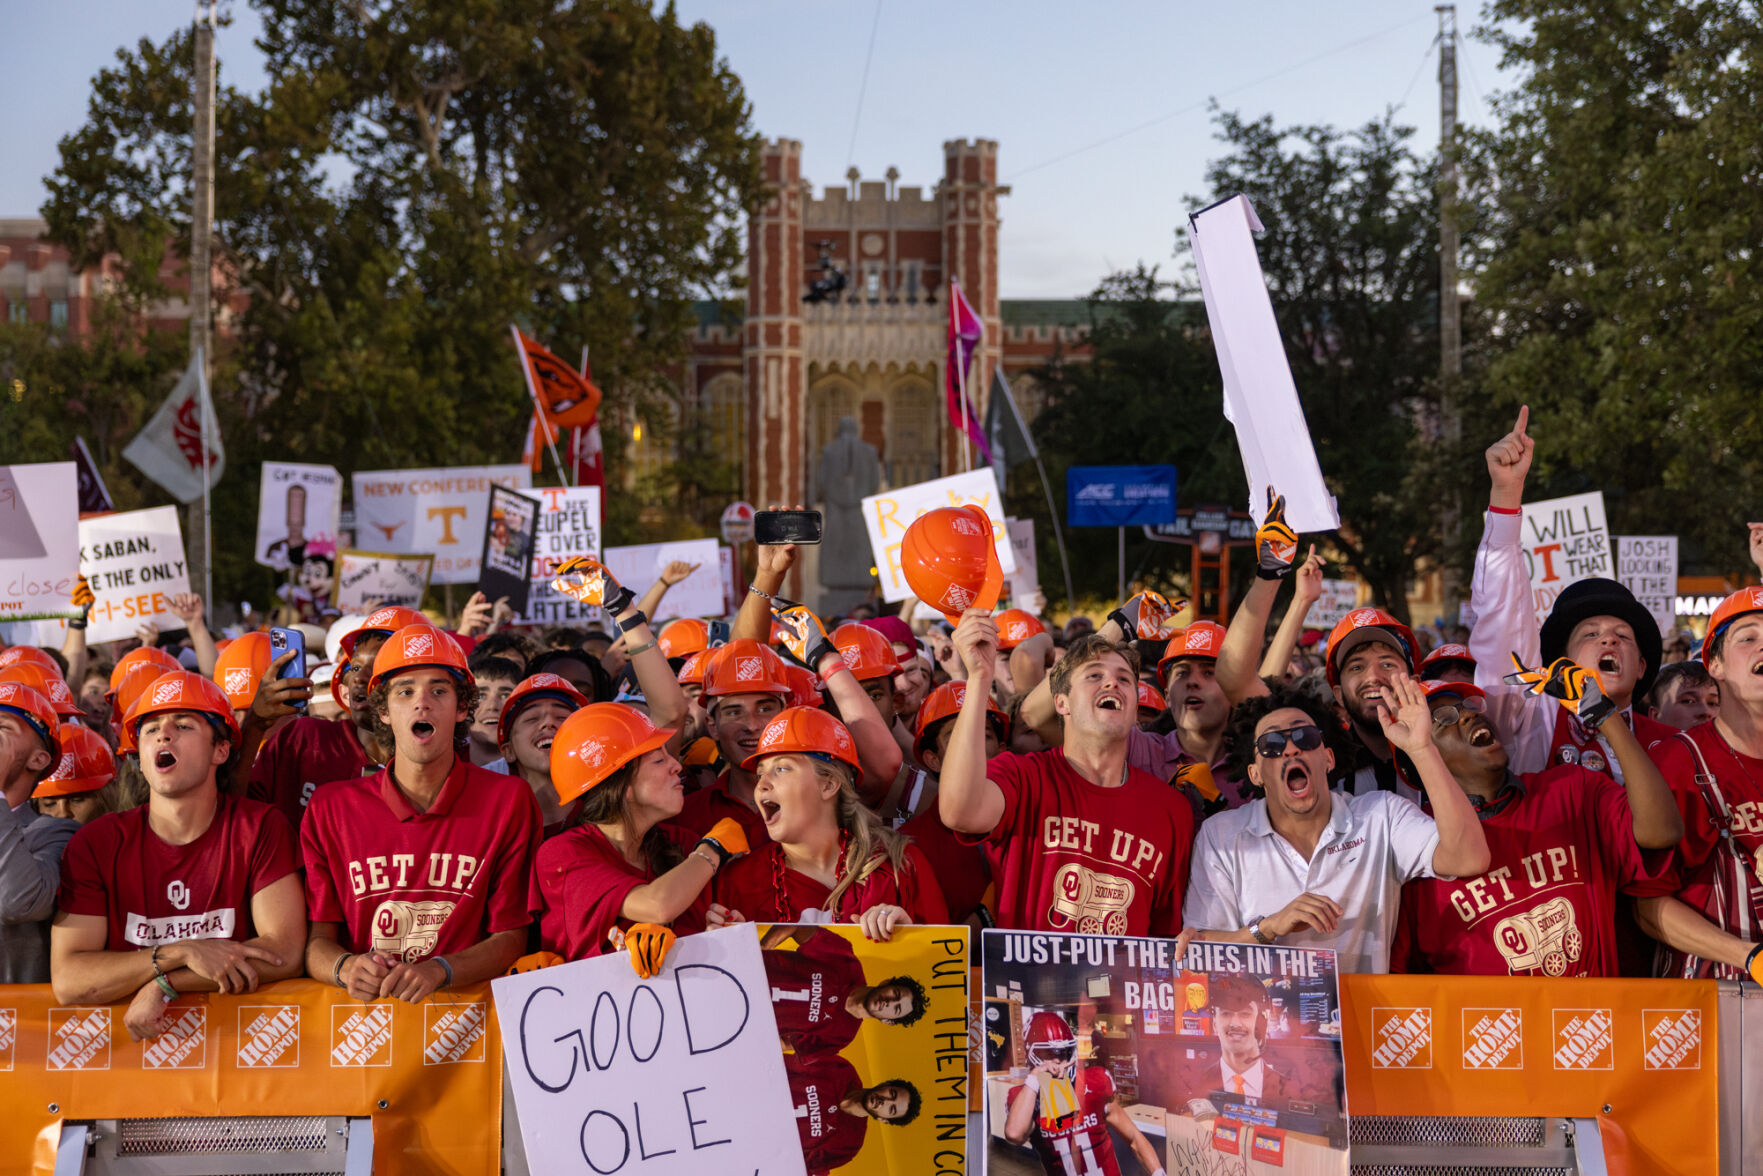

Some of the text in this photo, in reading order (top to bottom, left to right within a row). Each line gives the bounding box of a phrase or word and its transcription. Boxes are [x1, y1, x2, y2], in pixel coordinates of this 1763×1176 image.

[364, 482, 404, 497] NEW
[542, 489, 588, 511] THE
[875, 490, 990, 538] Rky
[1528, 506, 1602, 542] WILL
[93, 537, 156, 560] SABAN,
[551, 533, 595, 552] OVER
[1563, 534, 1606, 557] WEAR
[1622, 541, 1670, 557] JOSH
[105, 568, 135, 590] THE
[140, 562, 184, 583] ONLY
[1565, 553, 1609, 577] THAT
[1621, 559, 1671, 574] LOOKING
[7, 572, 72, 597] close
[1639, 578, 1667, 593] THE
[0, 601, 24, 611] POT
[1675, 597, 1725, 615] MAK
[404, 634, 433, 657] HOME
[1186, 630, 1212, 649] HOME
[225, 668, 250, 695] HOME
[737, 657, 761, 680] HOME
[153, 680, 183, 705] HOME
[1727, 801, 1763, 833] GE
[1044, 816, 1163, 880] GET UP!
[1327, 837, 1366, 854] OKLAHOMA
[349, 853, 485, 895] GET UP!
[1062, 871, 1081, 901] OU
[1450, 845, 1578, 922] GET UP!
[167, 880, 190, 910] OU
[1095, 885, 1124, 900] SOONERS
[378, 909, 398, 937] OU
[416, 913, 449, 926] SOONERS
[1537, 909, 1566, 933] SOONERS
[1501, 926, 1528, 954] OU
[931, 938, 968, 995] PUT
[1003, 934, 1062, 965] JUST
[1069, 938, 1118, 967] PUT
[1125, 940, 1169, 968] THE
[1246, 946, 1271, 974] IN
[1276, 949, 1320, 978] THE
[771, 987, 810, 1002] 1
[808, 973, 822, 1023] SOONERS
[1124, 981, 1174, 1011] BAG
[56, 1015, 81, 1040] THE
[238, 1006, 299, 1067] HOME
[245, 1013, 270, 1036] THE
[331, 1005, 392, 1066] HOME
[338, 1011, 363, 1035] THE
[425, 1003, 485, 1064] HOME
[431, 1010, 456, 1034] THE
[520, 964, 749, 1093] GOOD
[1378, 1014, 1403, 1038] THE
[1469, 1015, 1493, 1039] THE
[1559, 1016, 1584, 1039] THE
[1650, 1016, 1674, 1040] THE
[49, 1008, 110, 1069] HOME
[72, 1031, 110, 1069] DEPOT
[144, 1008, 205, 1068] HOME
[168, 1029, 205, 1068] DEPOT
[261, 1028, 298, 1067] DEPOT
[355, 1027, 391, 1066] DEPOT
[449, 1023, 485, 1062] DEPOT
[1373, 1008, 1431, 1067] HOME
[1396, 1030, 1431, 1067] DEPOT
[1464, 1009, 1521, 1068] HOME
[1486, 1031, 1521, 1068] DEPOT
[1554, 1009, 1611, 1069] HOME
[1577, 1031, 1612, 1069] DEPOT
[1646, 1009, 1700, 1069] HOME
[1666, 1031, 1700, 1068] DEPOT
[934, 1006, 969, 1101] THEM
[805, 1085, 821, 1137] SOONERS
[580, 1086, 732, 1175] OLE
[934, 1114, 966, 1141] IN
[1052, 1131, 1105, 1176] 11
